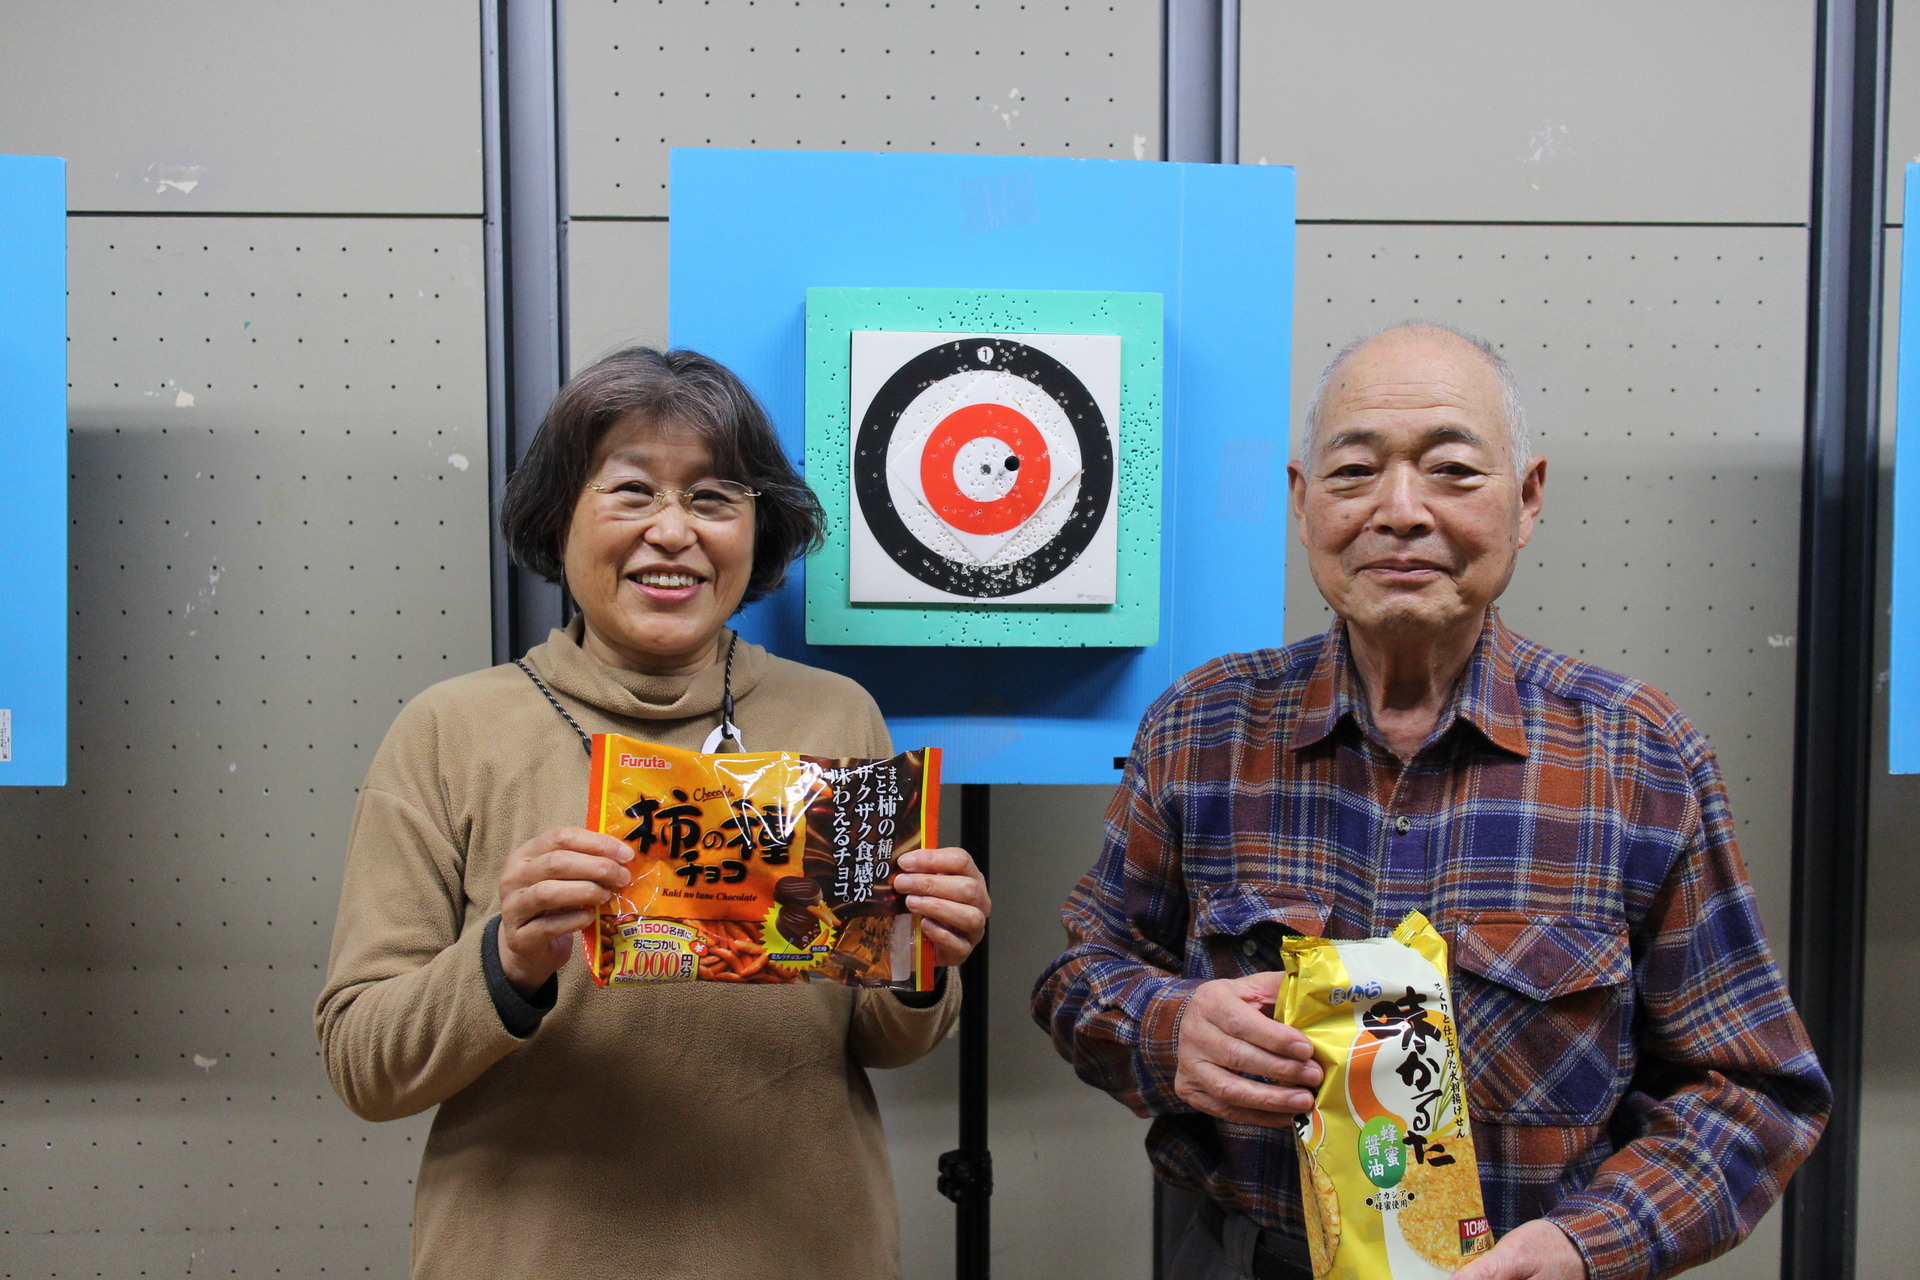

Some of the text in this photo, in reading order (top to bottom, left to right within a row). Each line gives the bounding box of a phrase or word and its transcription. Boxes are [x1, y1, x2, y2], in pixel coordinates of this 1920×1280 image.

[620, 755, 667, 769] Furuta
[624, 788, 795, 865] 柿の種
[854, 765, 875, 903] ザクザク食感が
[675, 850, 748, 887] チョコ
[662, 888, 682, 897] Kaki
[696, 892, 714, 900] tane
[716, 892, 758, 902] Chocolate
[633, 939, 681, 950] おこづかい
[1329, 981, 1382, 1005] ぼんち
[1362, 985, 1456, 1168] 味かるた
[1380, 1124, 1400, 1167] 蜂蜜
[1375, 1190, 1406, 1201] アカシア
[1375, 1200, 1408, 1211] 蜂蜜使用
